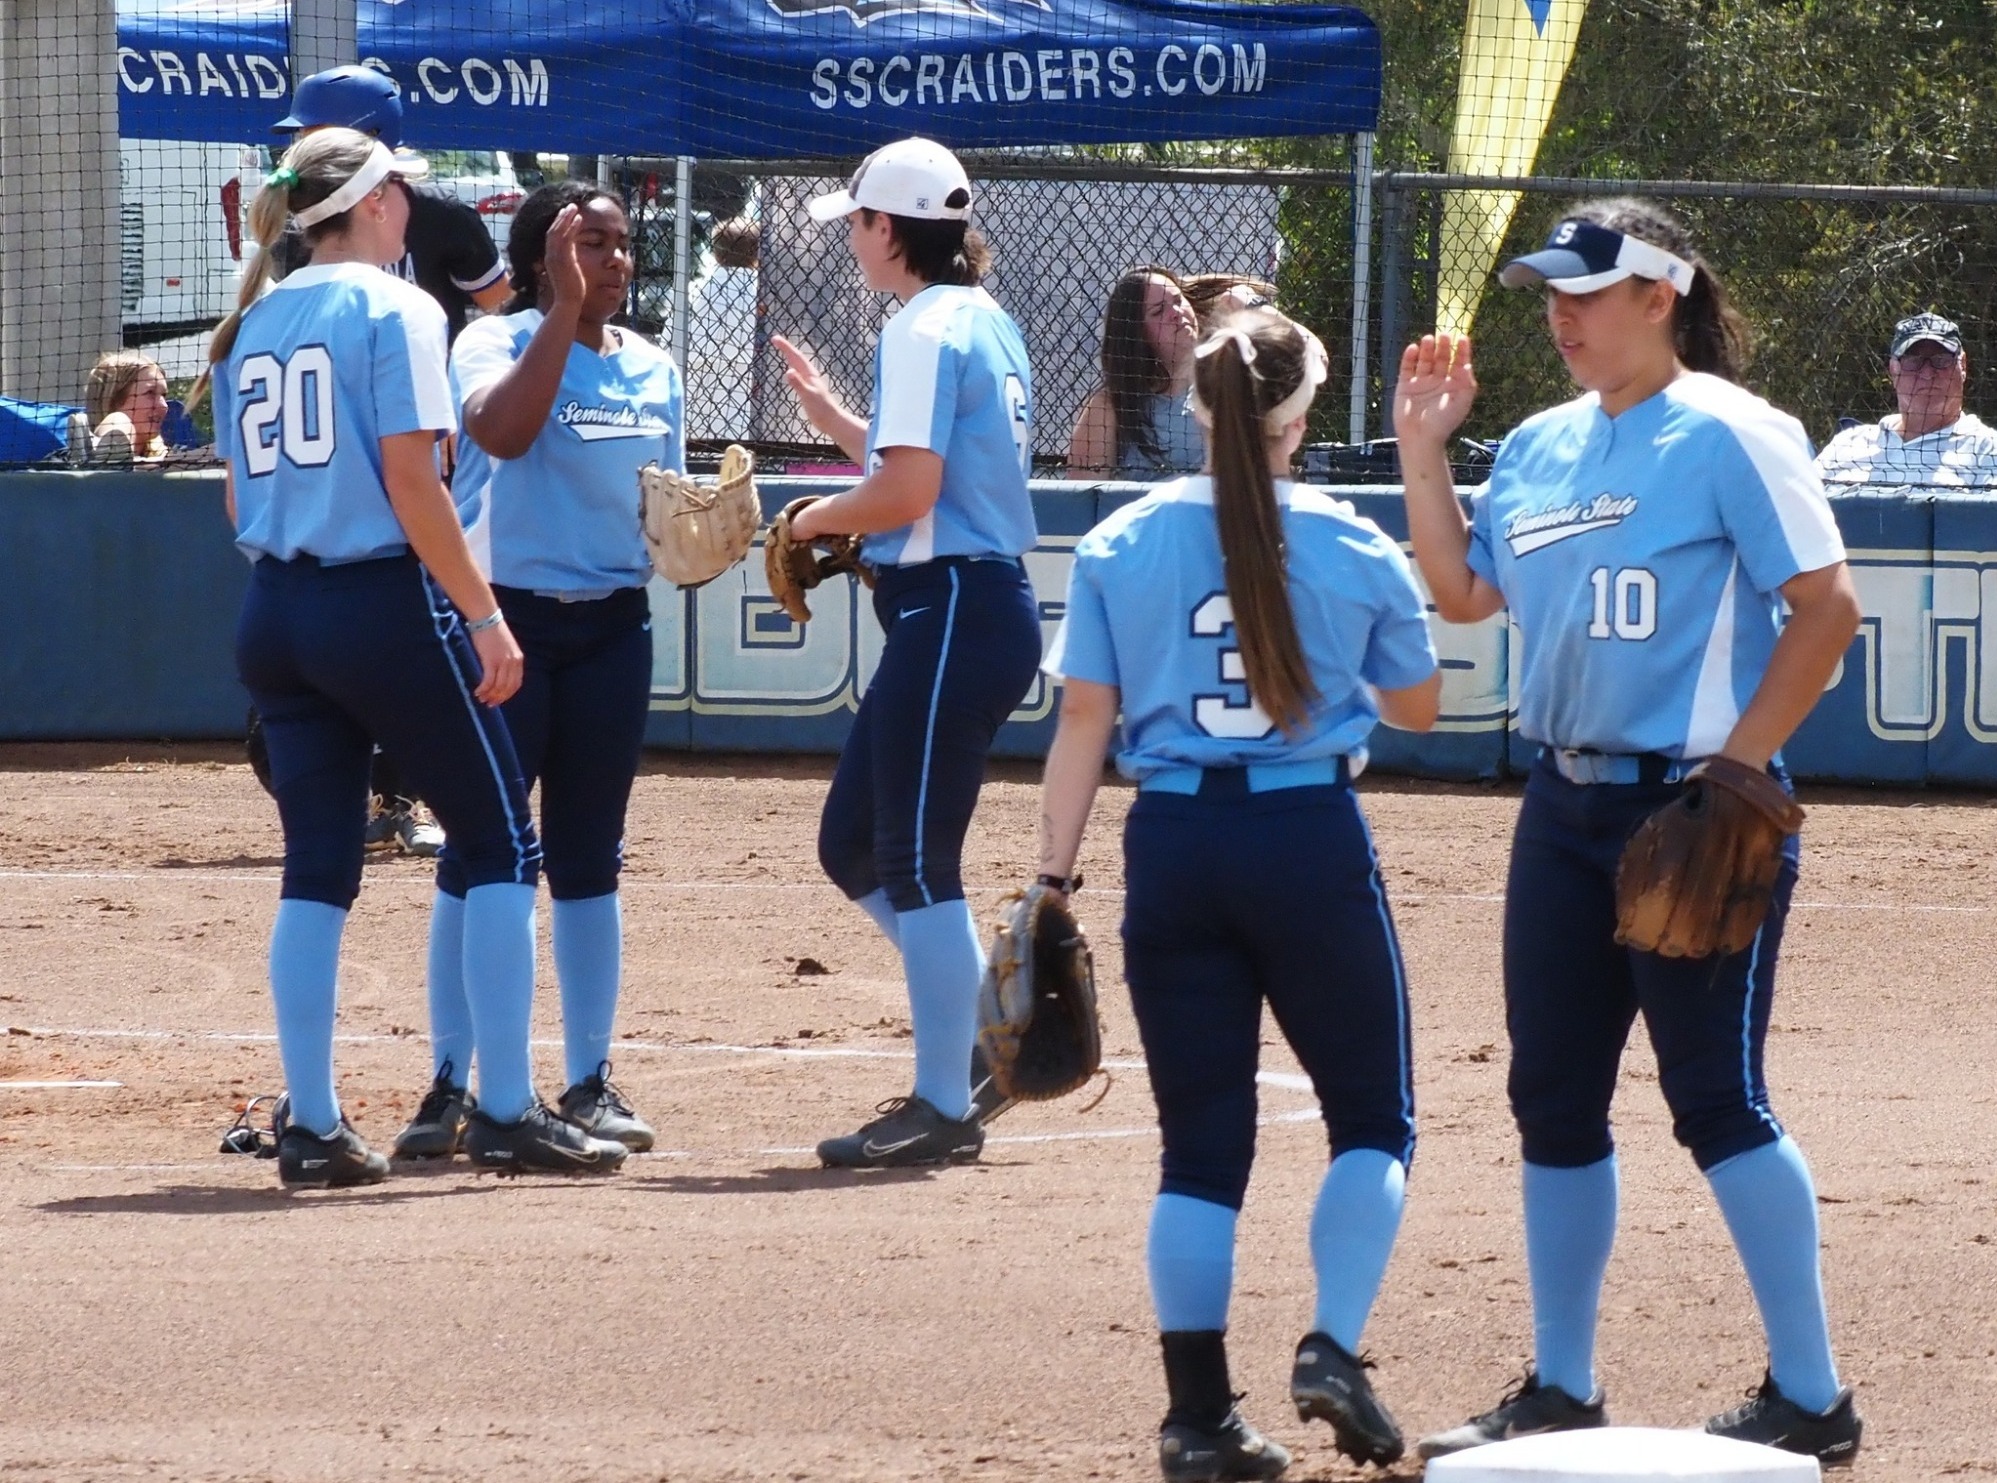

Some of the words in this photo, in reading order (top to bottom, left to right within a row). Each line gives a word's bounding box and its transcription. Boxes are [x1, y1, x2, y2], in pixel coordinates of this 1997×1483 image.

[810, 42, 1267, 110] SSCRAIDERS.COM
[1555, 222, 1578, 245] S
[239, 343, 336, 478] 20
[557, 401, 638, 427] Seminole
[1588, 566, 1658, 641] 10
[1190, 590, 1277, 741] 3
